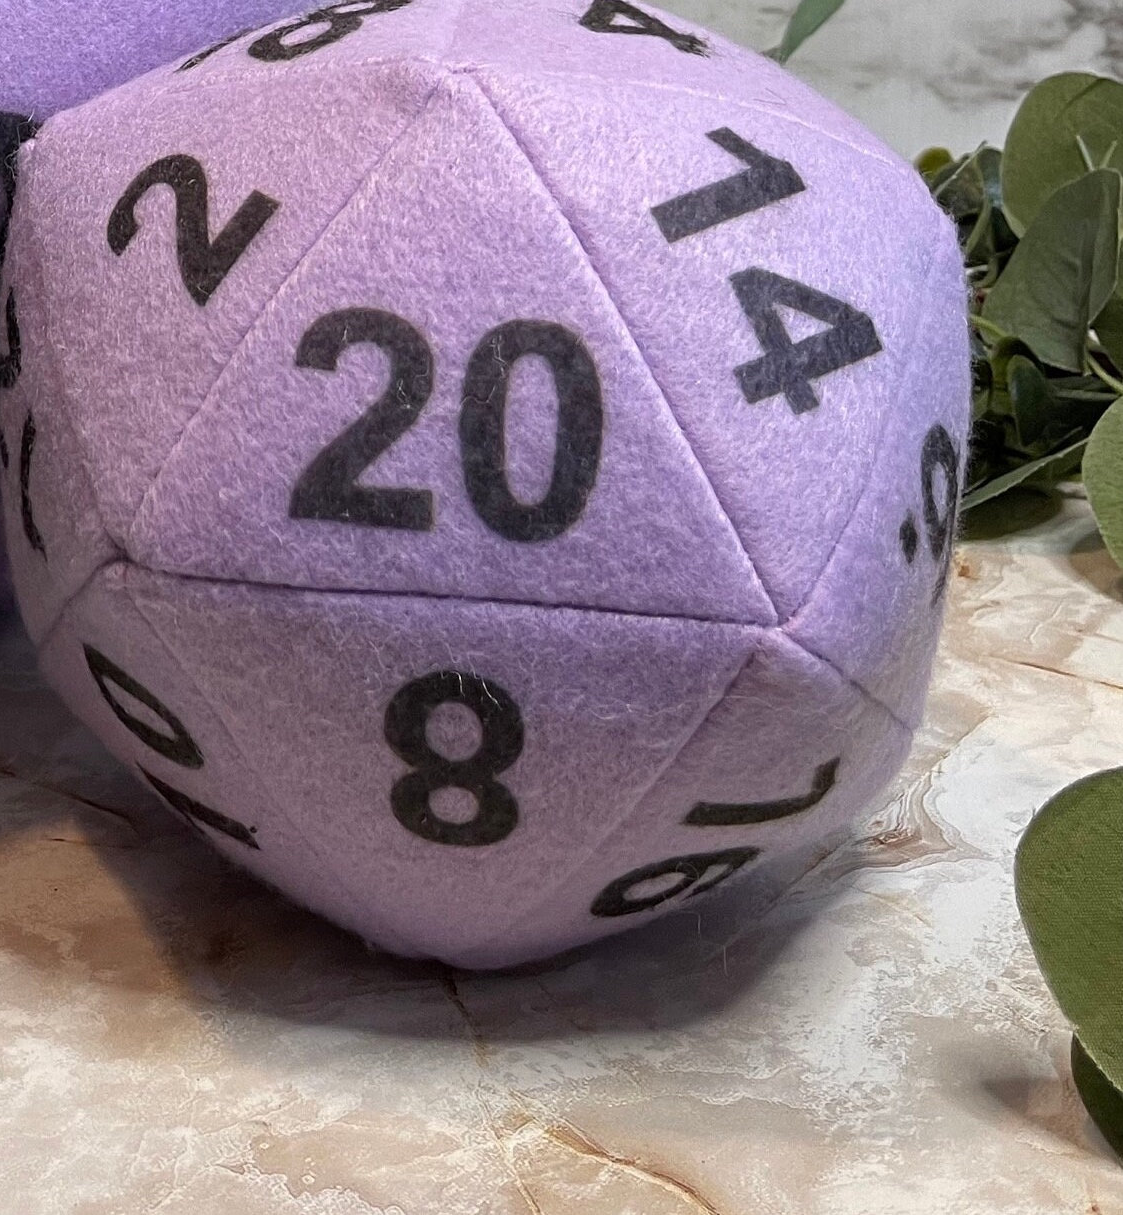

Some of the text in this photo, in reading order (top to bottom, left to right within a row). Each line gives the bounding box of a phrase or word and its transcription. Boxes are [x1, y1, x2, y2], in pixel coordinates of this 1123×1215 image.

[107, 154, 278, 307] 2
[650, 126, 883, 415] 14
[289, 307, 603, 543] 20
[384, 670, 526, 847] 8
